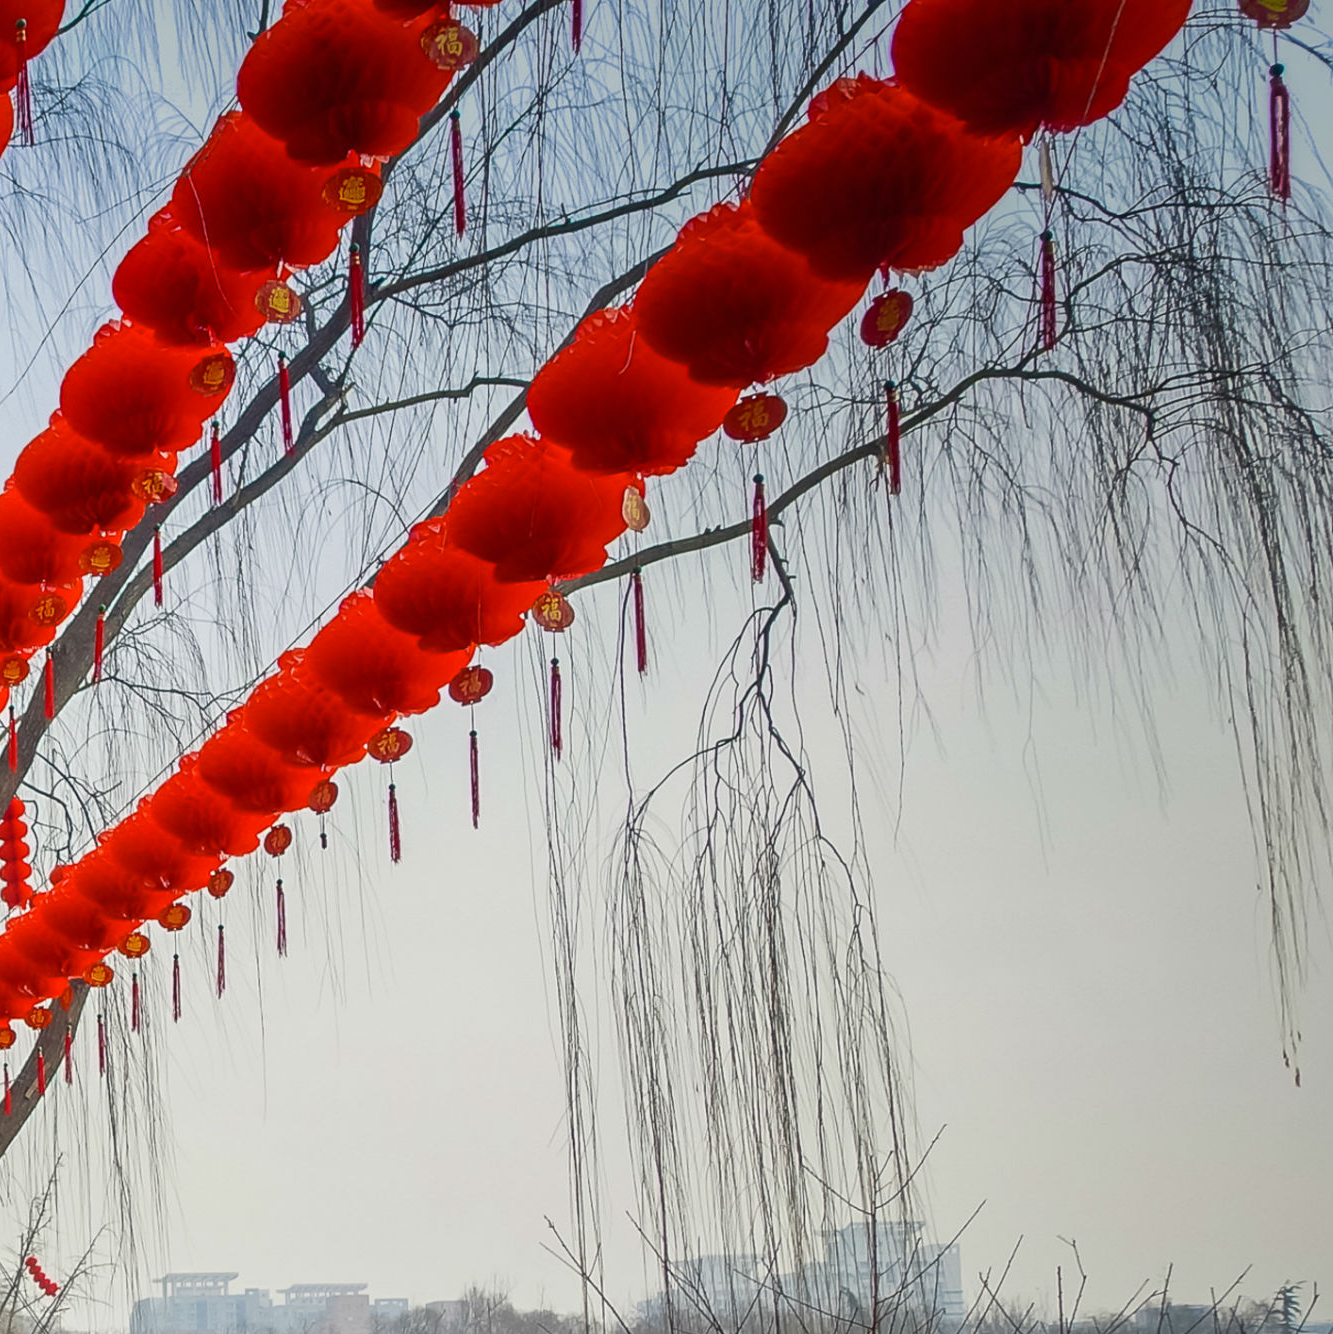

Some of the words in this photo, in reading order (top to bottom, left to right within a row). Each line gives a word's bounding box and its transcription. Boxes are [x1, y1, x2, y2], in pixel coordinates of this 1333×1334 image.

[436, 27, 464, 57] 福
[738, 400, 769, 431] 福
[143, 478, 165, 495] 福
[626, 494, 641, 521] 福
[37, 599, 55, 620] 福
[541, 598, 563, 622] 福
[459, 670, 481, 695] 福
[377, 734, 400, 756] 福
